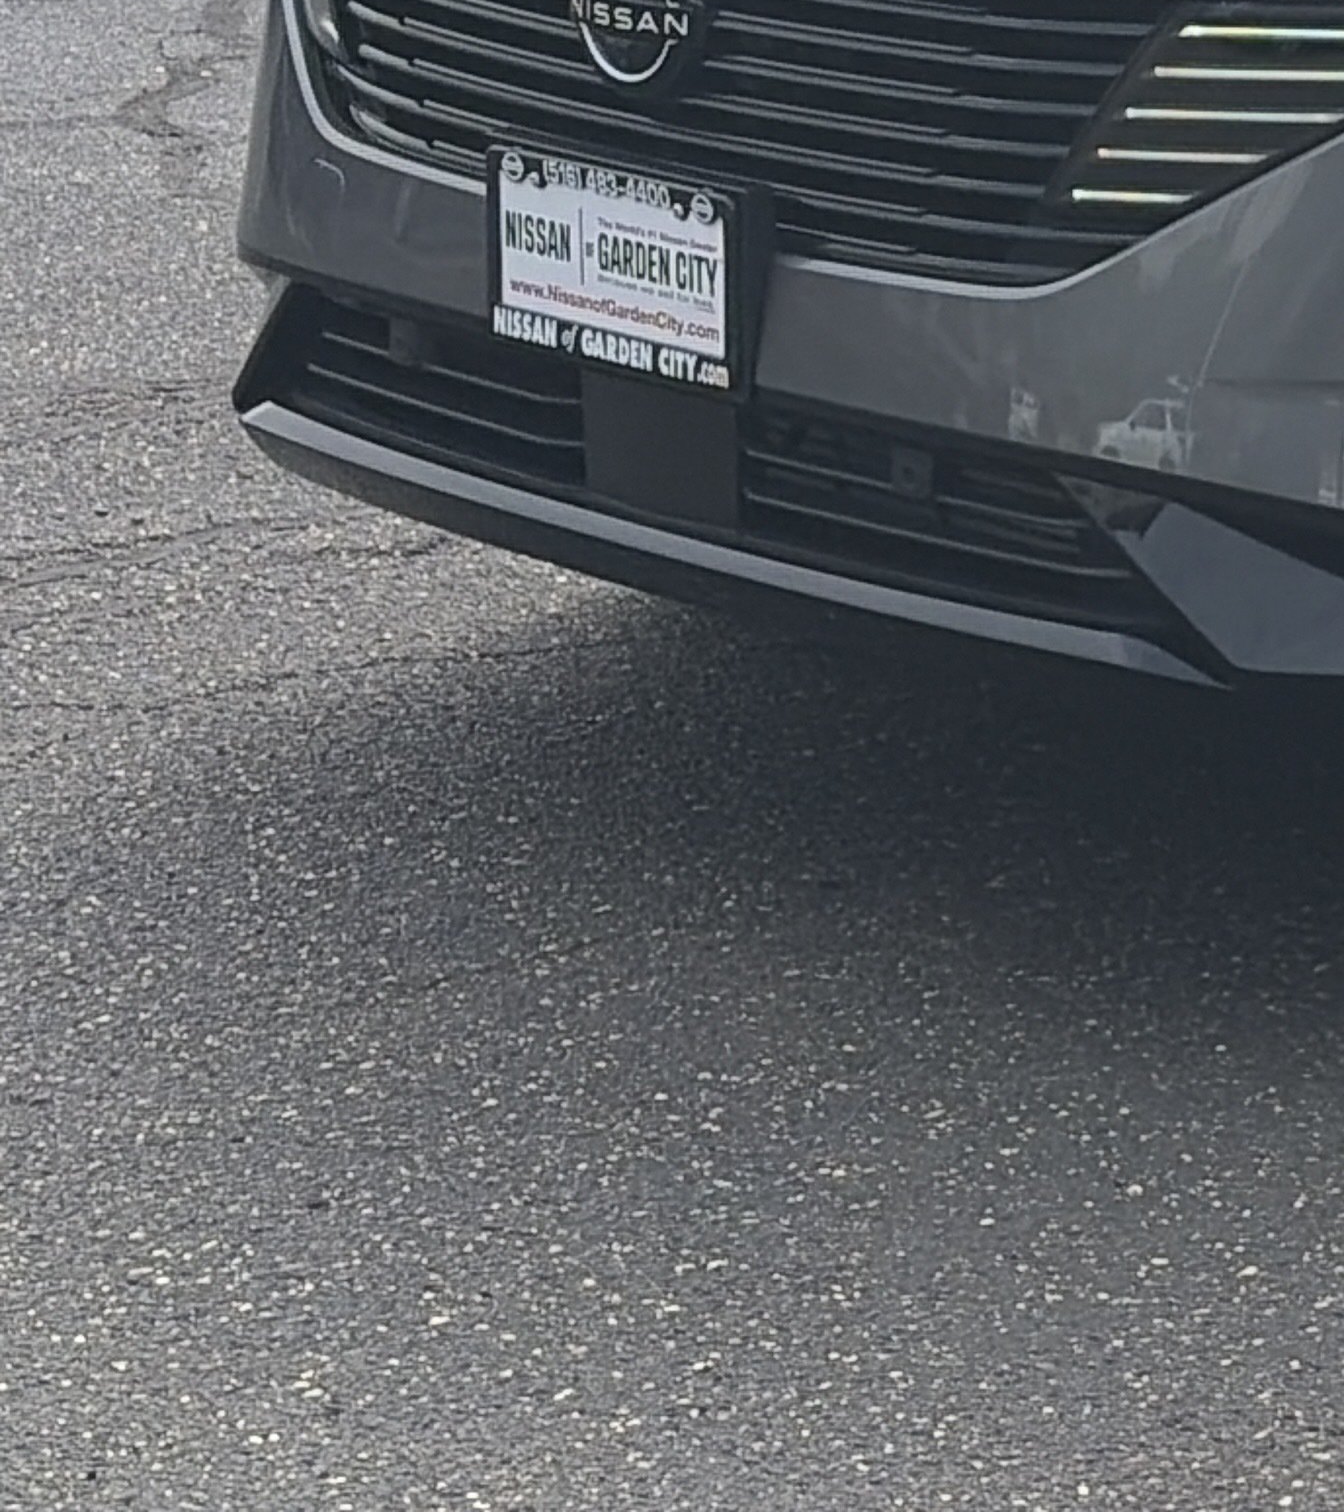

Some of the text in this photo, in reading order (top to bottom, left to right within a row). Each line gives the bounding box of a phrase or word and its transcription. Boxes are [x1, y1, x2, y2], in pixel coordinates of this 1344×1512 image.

[504, 209, 571, 263] NISSAN
[597, 231, 671, 287] GARDEN
[675, 250, 718, 299] CITY
[493, 304, 558, 350] NISSAN
[561, 323, 580, 354] of
[581, 328, 653, 373] GARDEN
